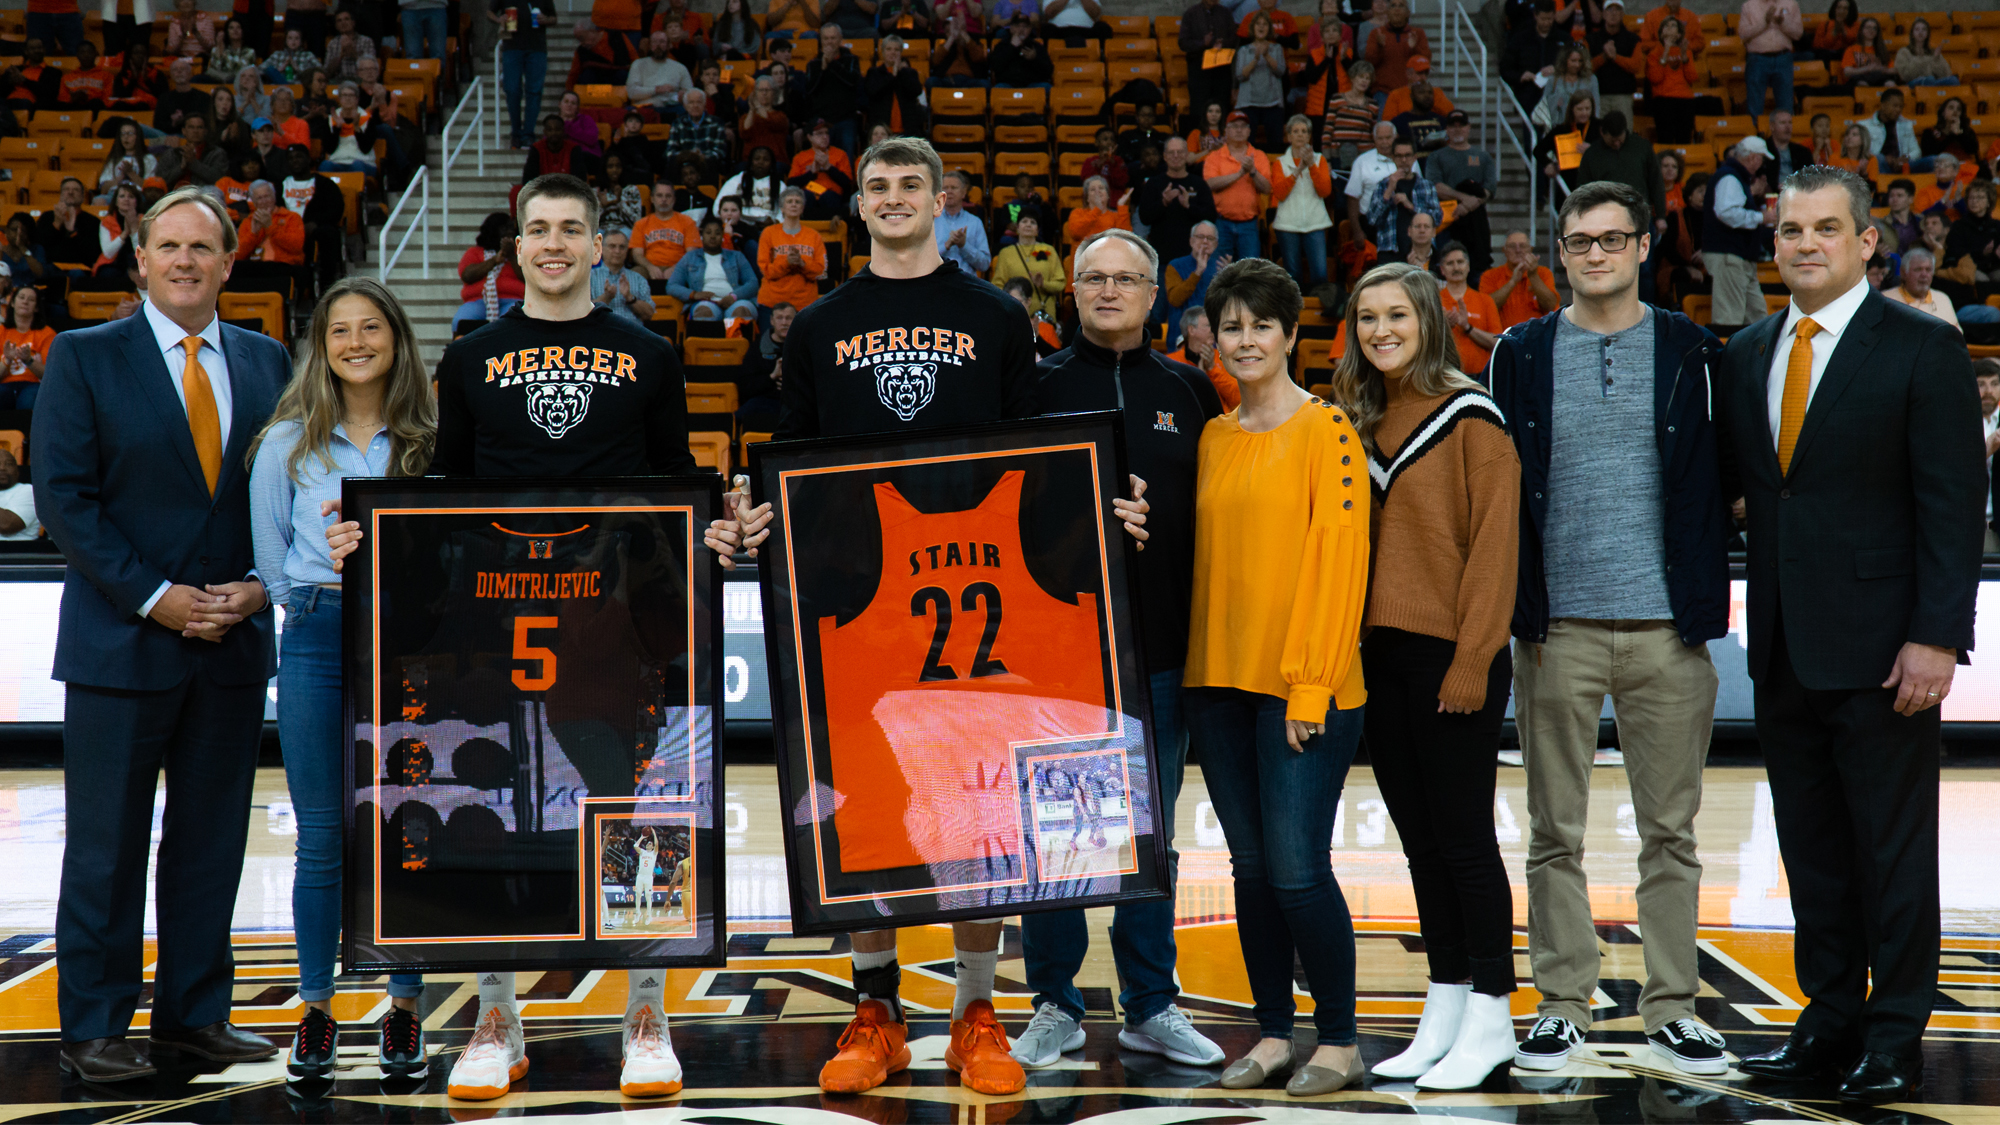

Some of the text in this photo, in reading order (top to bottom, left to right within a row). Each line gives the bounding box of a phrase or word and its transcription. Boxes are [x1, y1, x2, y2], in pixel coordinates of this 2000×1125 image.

[773, 244, 814, 259] MEER
[835, 326, 977, 366] MERCER
[849, 351, 963, 371] BASKETBALL
[485, 345, 637, 383] MERCER
[500, 370, 621, 388] BASKETBALL
[1153, 424, 1180, 434] MERCER
[909, 541, 1001, 577] STAIR
[475, 570, 601, 600] DIMITRIJEVIC
[910, 580, 1011, 683] 22
[511, 615, 559, 692] 5
